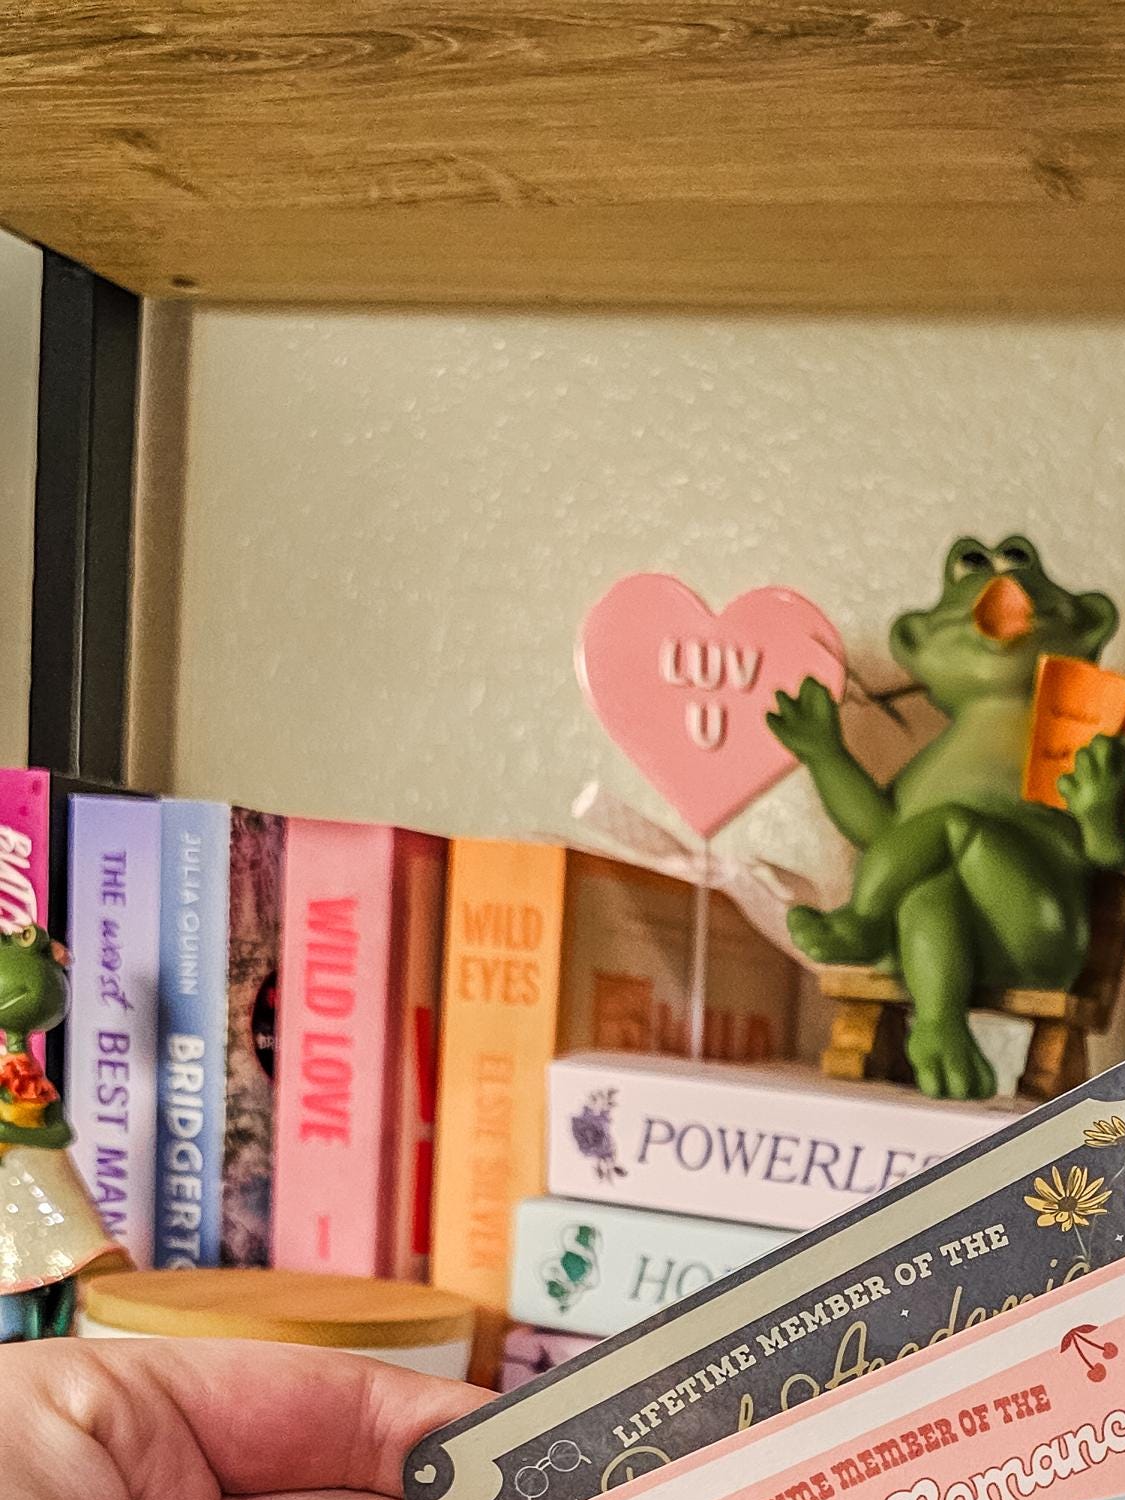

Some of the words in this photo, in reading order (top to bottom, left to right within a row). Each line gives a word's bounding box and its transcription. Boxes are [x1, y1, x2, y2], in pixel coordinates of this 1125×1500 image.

[660, 637, 763, 690] LUV
[683, 698, 728, 750] U
[101, 850, 127, 907] THE
[176, 832, 203, 908] JULIA
[175, 910, 202, 997] QUINN
[302, 897, 361, 1020] WILD
[459, 903, 545, 952] WILD
[456, 955, 543, 1008] EYES
[97, 1029, 131, 1133] BEST
[299, 1030, 356, 1148] LOVE
[636, 1116, 940, 1194] POWERLE
[612, 1344, 757, 1448] LIFETIME
[754, 1275, 891, 1357] MEMBER
[893, 1253, 935, 1287] OF
[936, 1223, 1010, 1268] THE
[830, 1417, 962, 1491] MEMBER
[958, 1406, 991, 1438] OF
[993, 1384, 1053, 1425] THE
